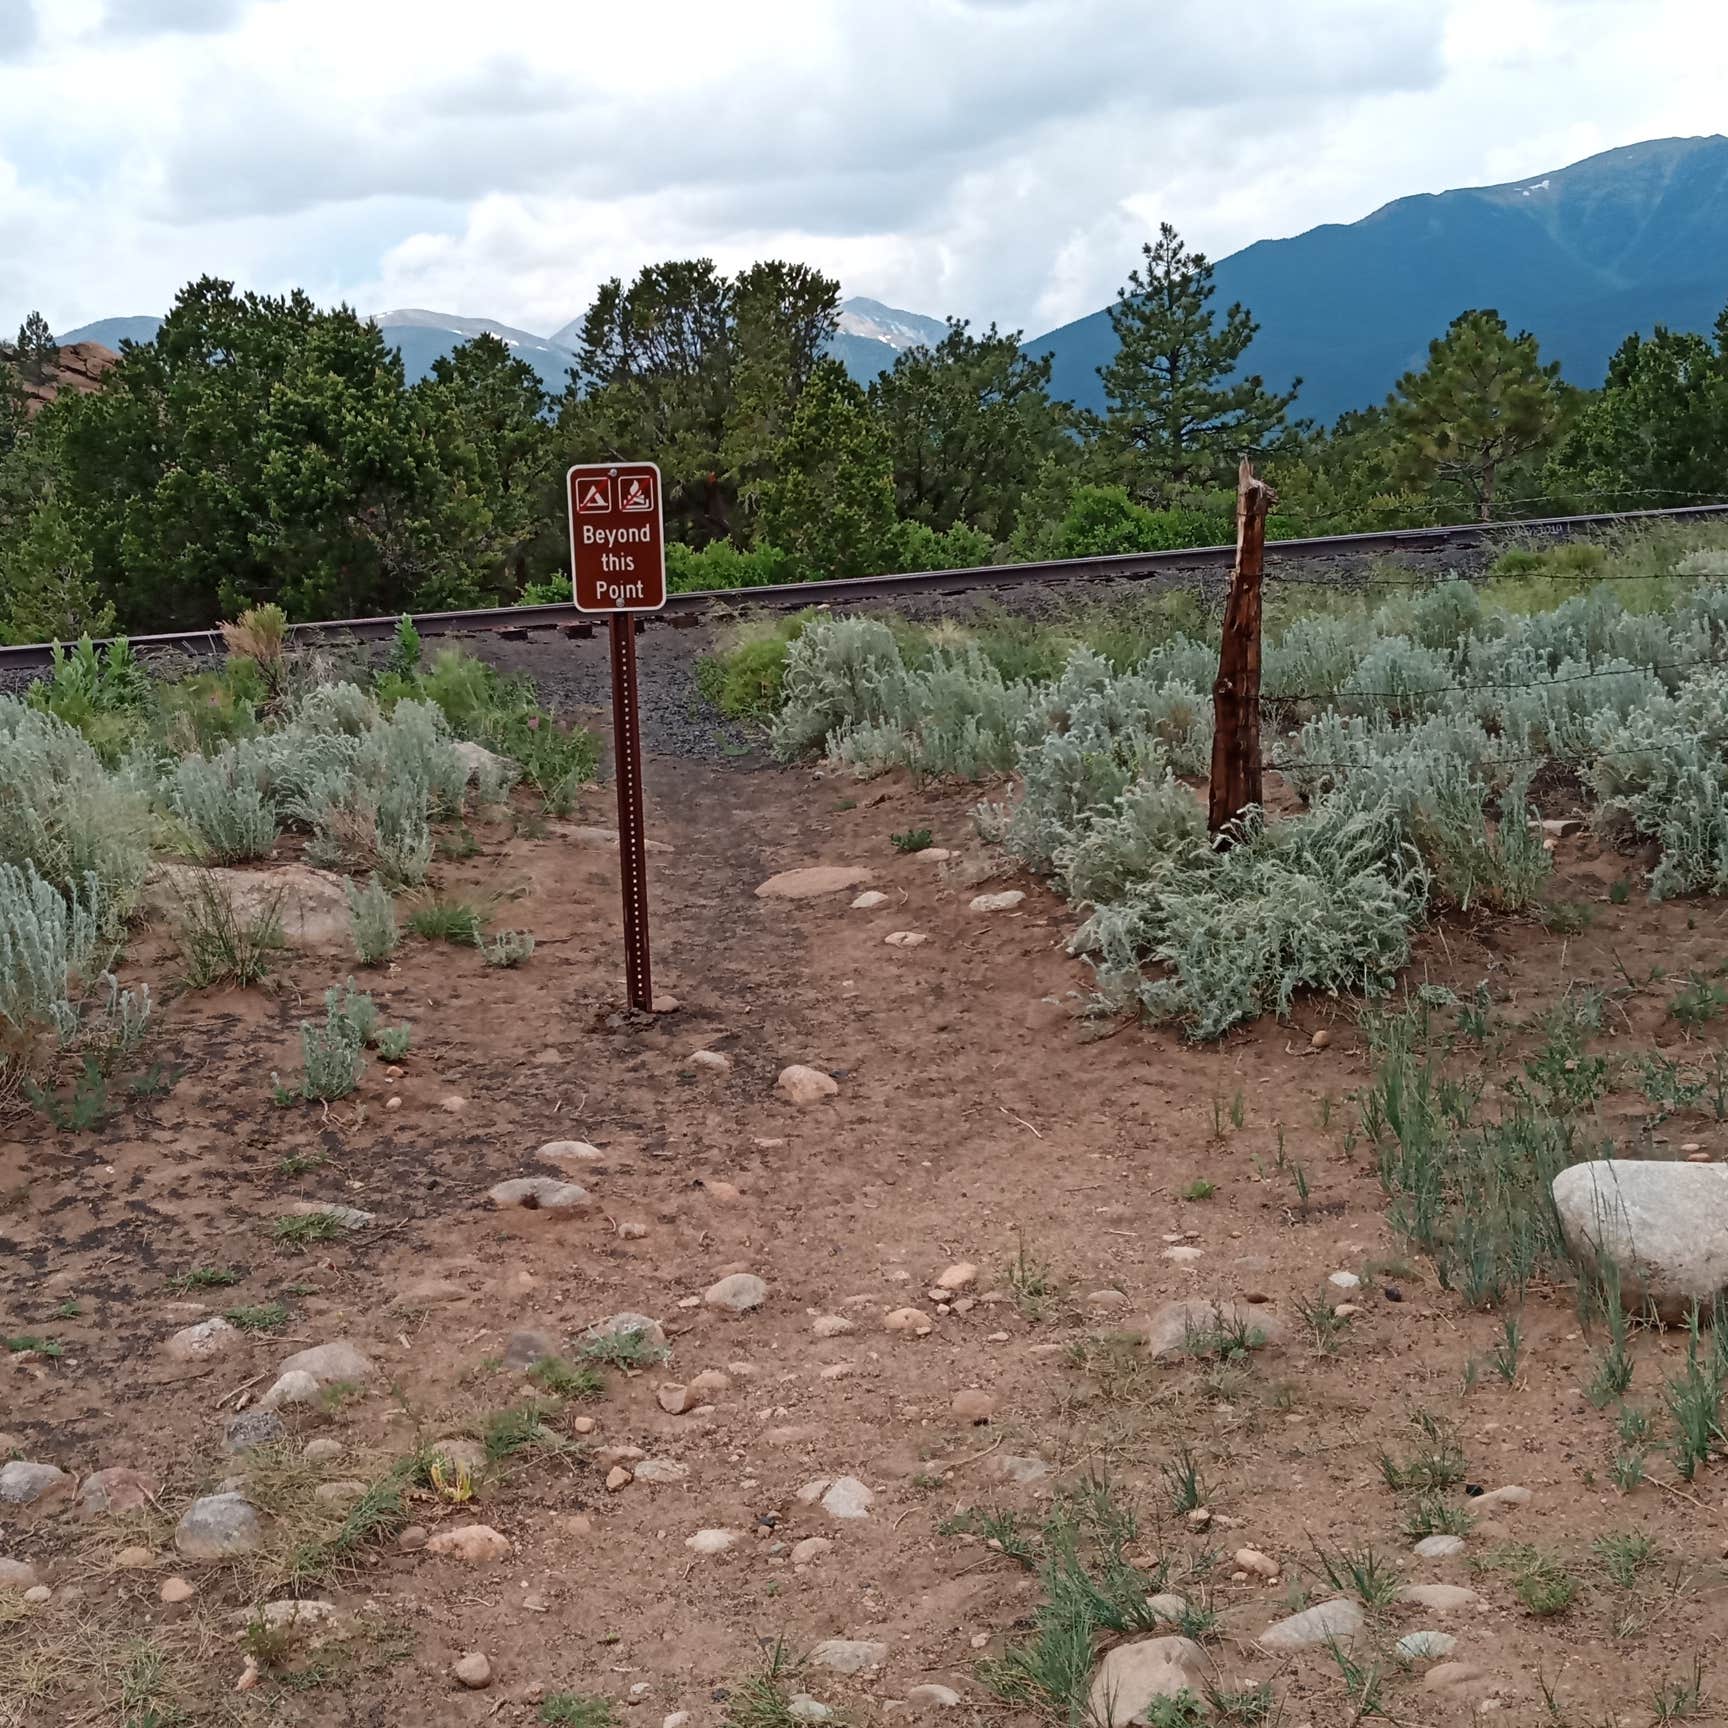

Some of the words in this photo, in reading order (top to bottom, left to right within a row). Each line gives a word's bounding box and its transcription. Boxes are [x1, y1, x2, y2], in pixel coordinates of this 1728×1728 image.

[583, 523, 650, 548] Beyond
[601, 552, 634, 571] this
[596, 580, 644, 600] Point
